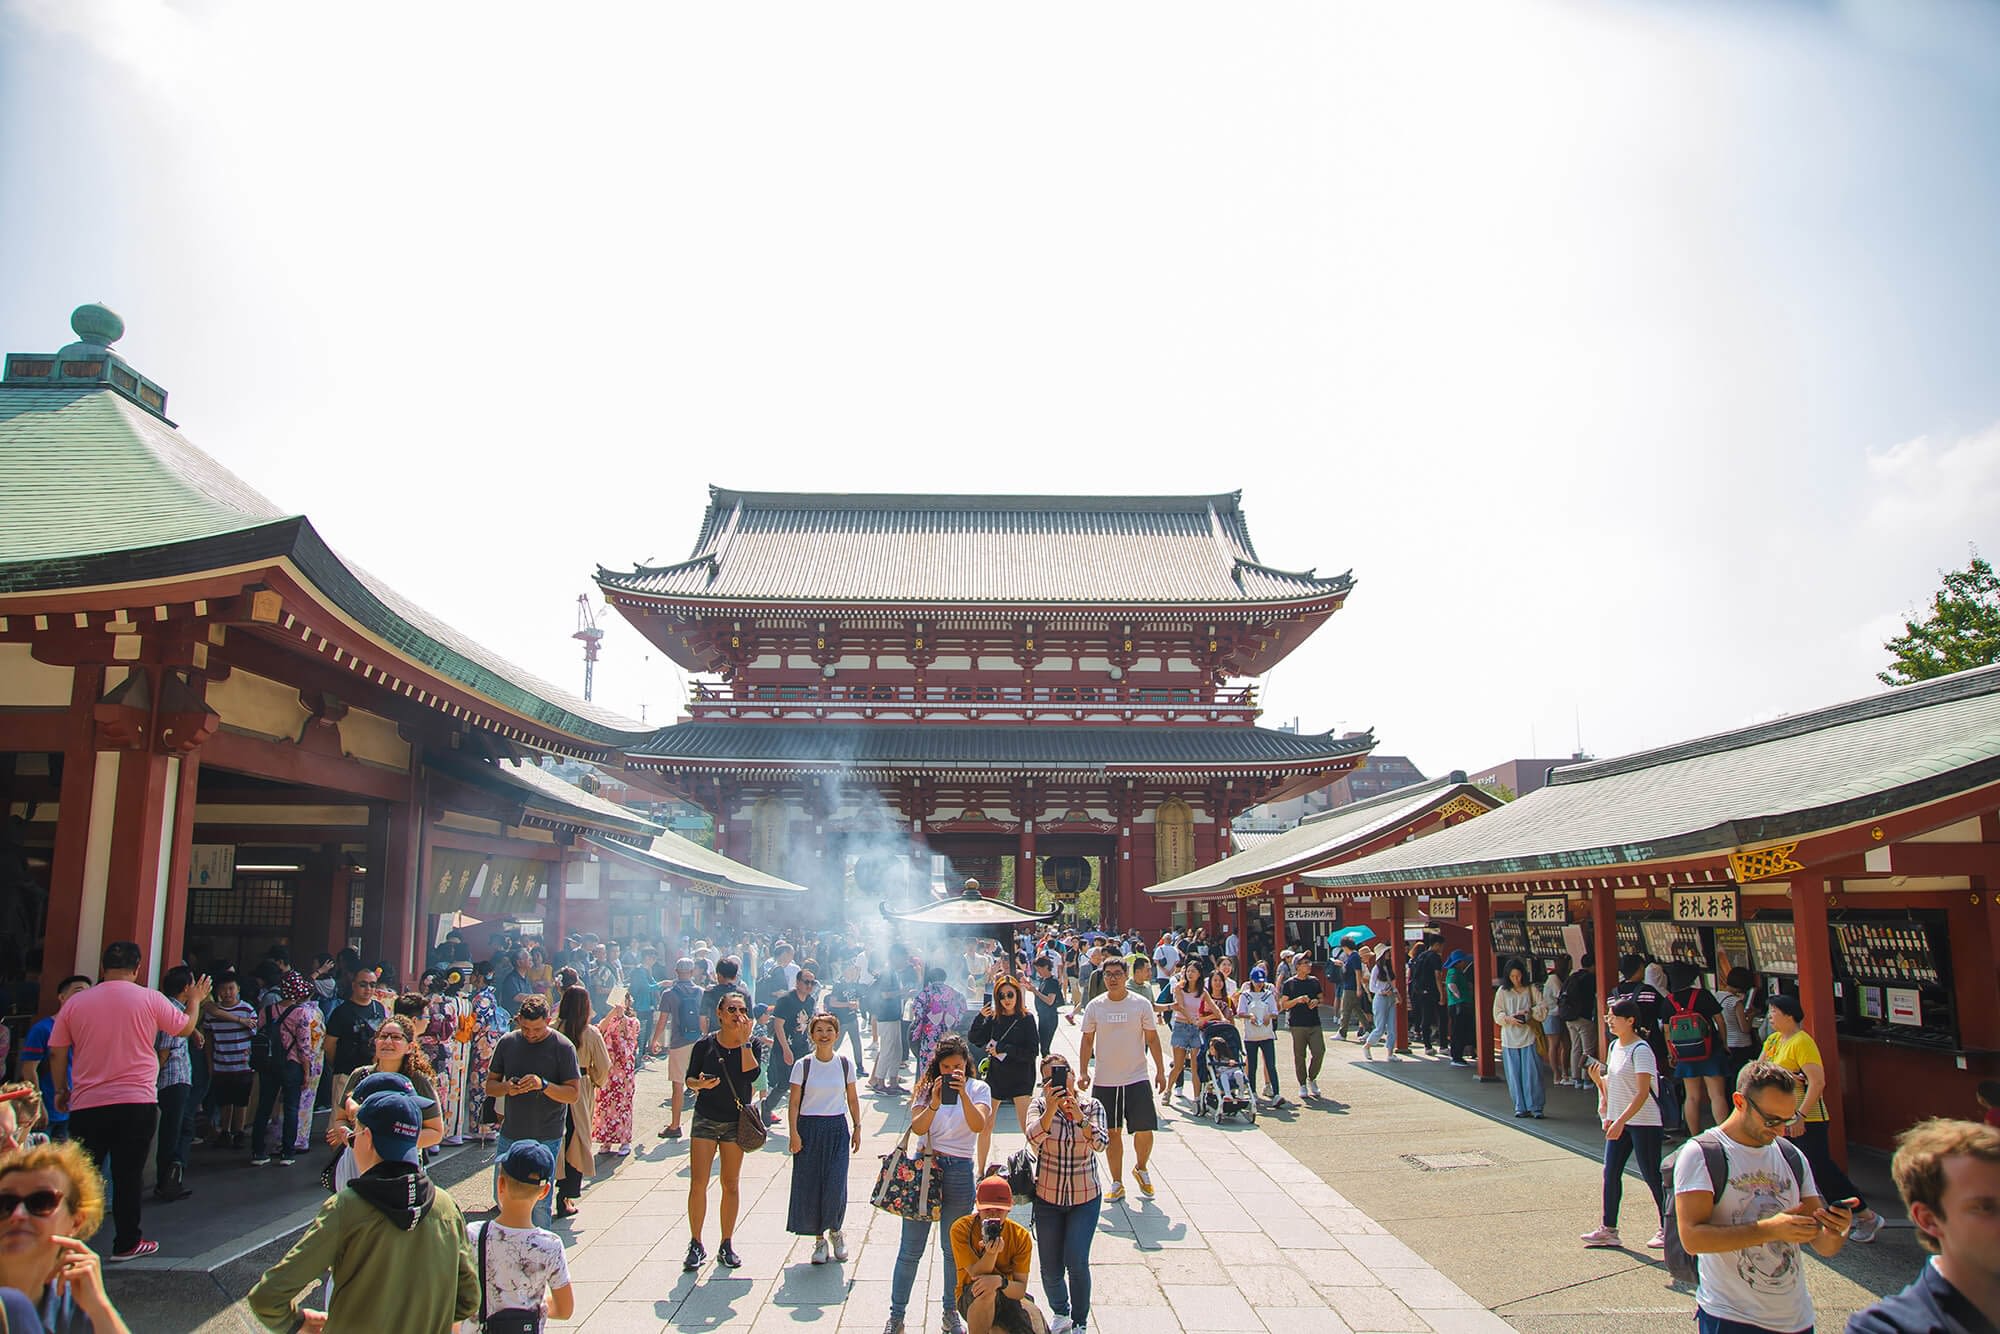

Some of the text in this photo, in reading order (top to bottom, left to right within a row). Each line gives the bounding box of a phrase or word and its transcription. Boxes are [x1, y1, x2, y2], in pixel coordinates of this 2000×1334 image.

[1287, 909, 1334, 919] 古札お納め所
[1432, 901, 1455, 915] お札お守
[1531, 902, 1564, 920] お札お守
[1679, 894, 1734, 918] お札お守
